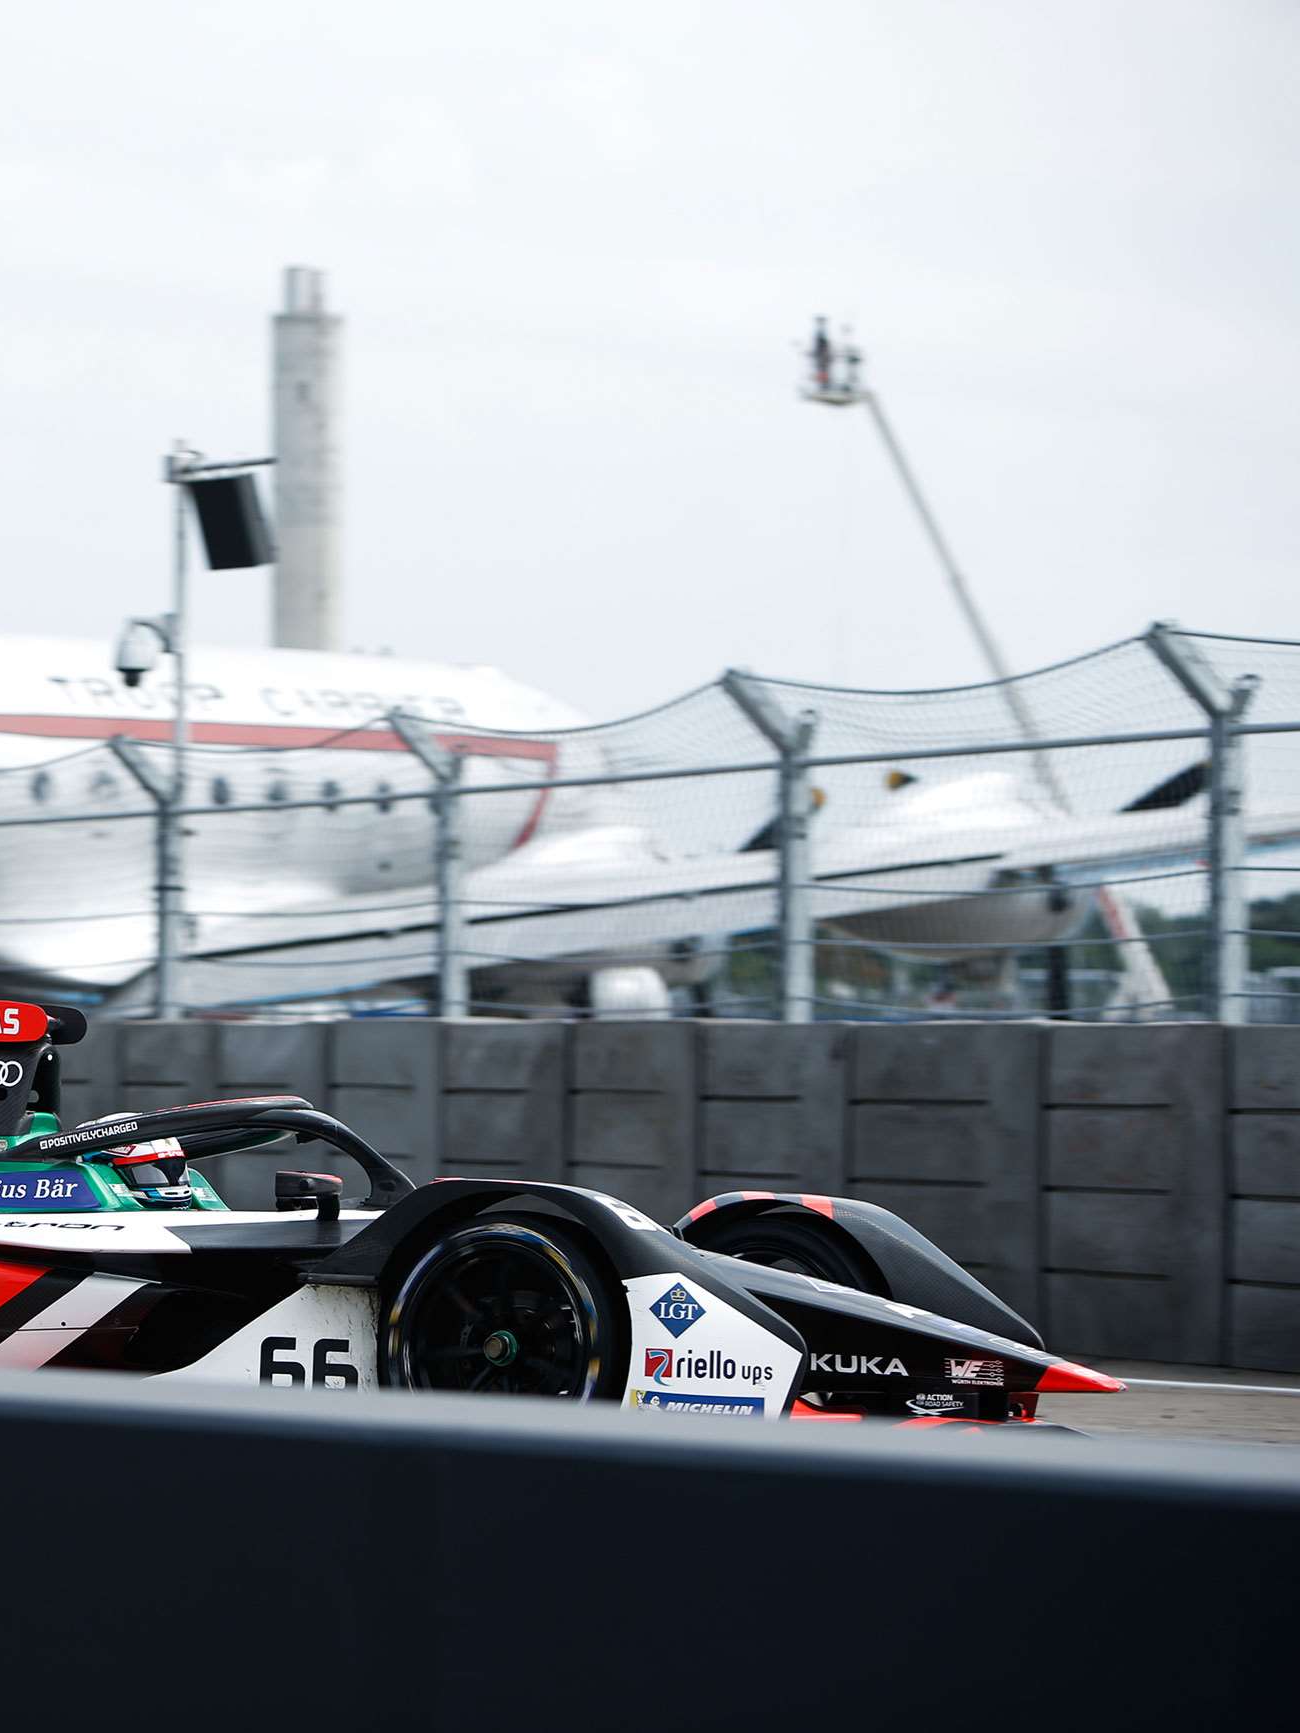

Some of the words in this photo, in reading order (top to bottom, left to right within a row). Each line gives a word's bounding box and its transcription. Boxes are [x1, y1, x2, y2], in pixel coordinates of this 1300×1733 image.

[33, 1178, 78, 1199] Bär
[658, 1301, 699, 1320] LGT
[259, 1336, 359, 1390] 66
[676, 1350, 736, 1379] riello
[741, 1365, 773, 1386] ups
[810, 1353, 909, 1376] KUKA
[664, 1402, 754, 1416] MICHELIN
